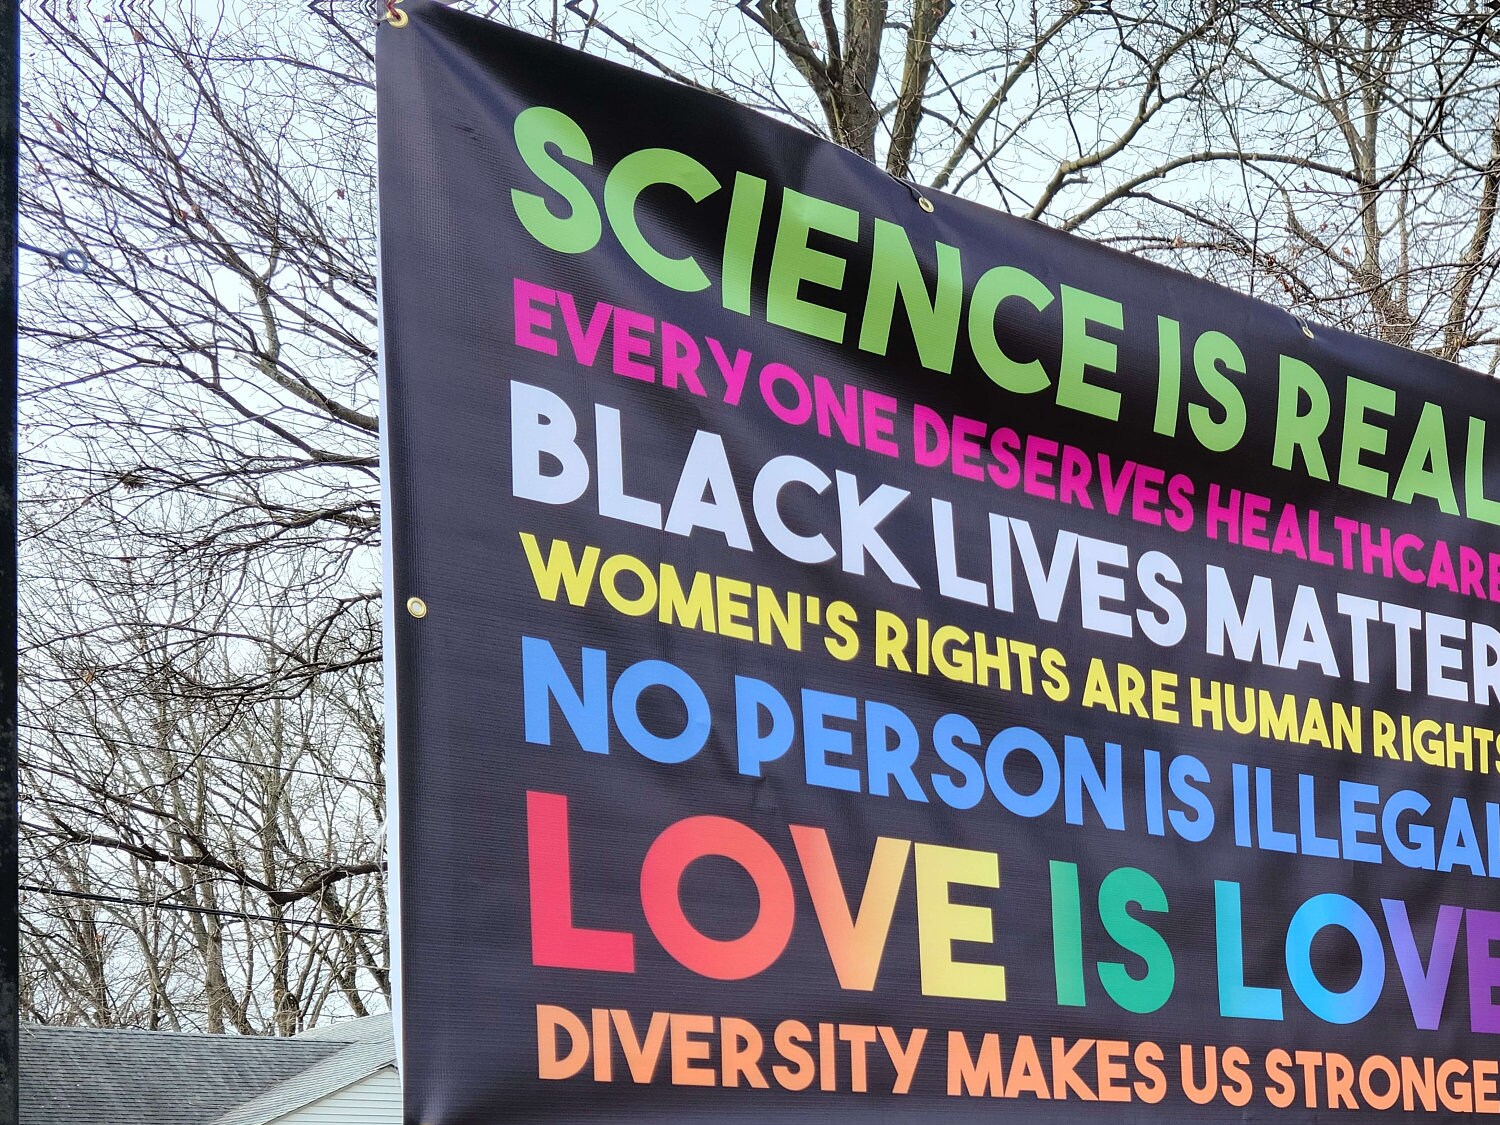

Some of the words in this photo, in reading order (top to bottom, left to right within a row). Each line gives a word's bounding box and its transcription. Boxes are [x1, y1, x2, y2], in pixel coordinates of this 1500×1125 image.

[510, 106, 1125, 421] SCIENCE
[1153, 314, 1247, 452] IS
[509, 379, 921, 590] BLACK
[930, 496, 1188, 648] LIVES
[513, 277, 900, 459] EVERYONE
[913, 403, 1195, 533] DESERVES
[518, 531, 860, 662] WOMEN'S
[875, 609, 1071, 702] RIGHTS
[1081, 657, 1180, 725] ARE
[1189, 676, 1363, 755] HUMAN
[521, 635, 713, 764] NO
[734, 673, 1126, 832] PERSON
[1143, 748, 1216, 843] IS
[525, 790, 1007, 1002] LOVE
[1049, 859, 1175, 1014] IS
[535, 1003, 929, 1095] DIVERSITY
[946, 1030, 1168, 1104] MAKES
[1179, 1043, 1253, 1107] US
